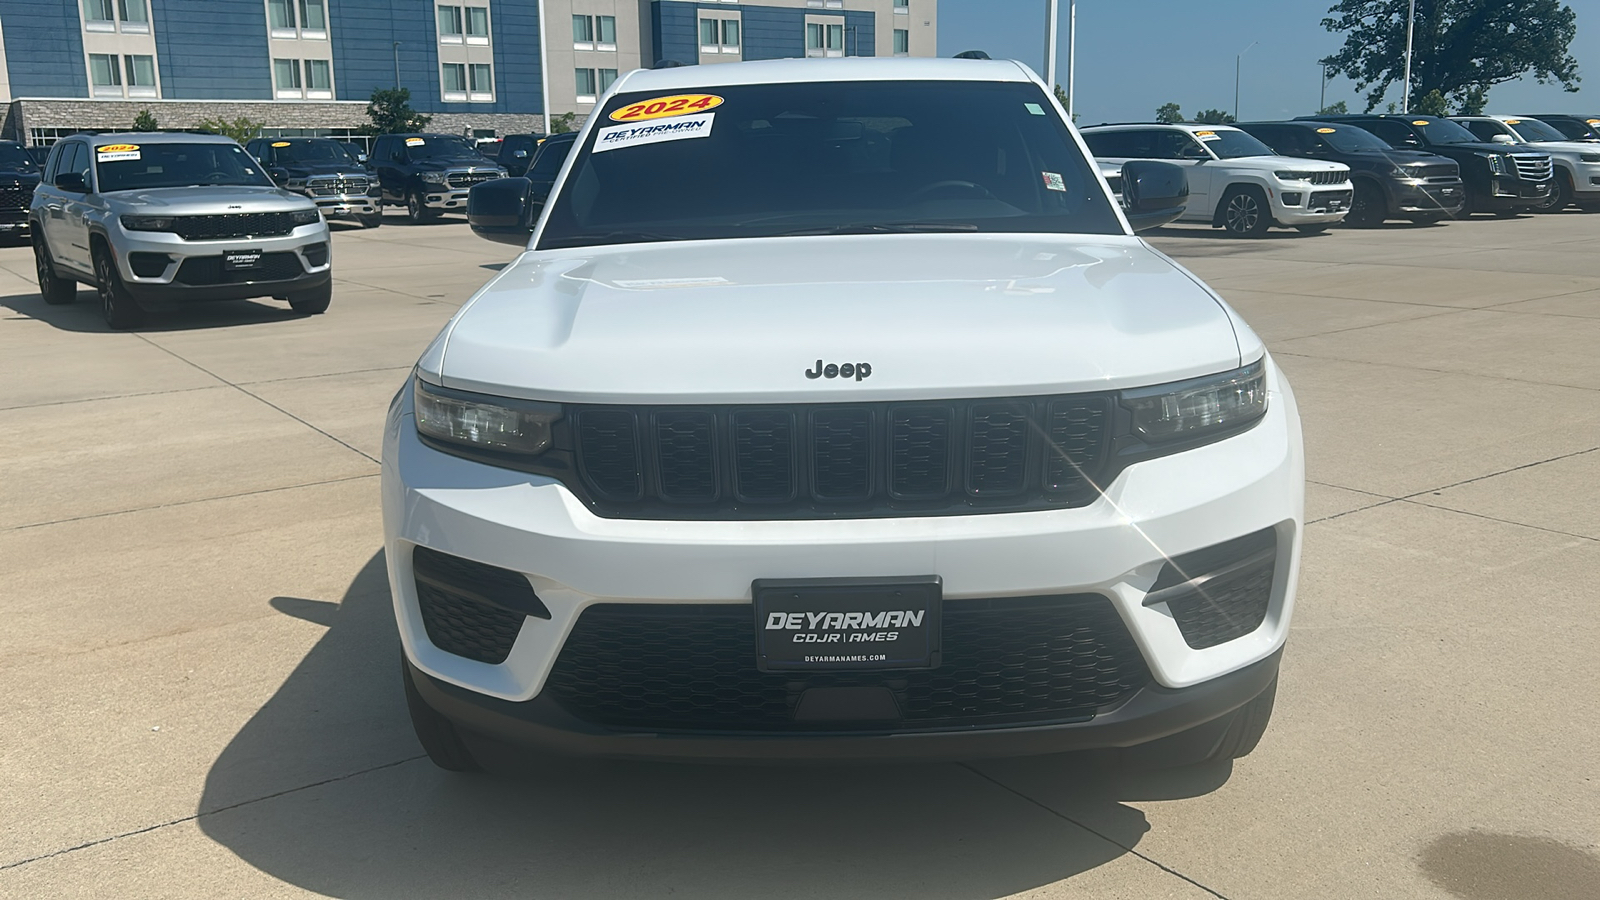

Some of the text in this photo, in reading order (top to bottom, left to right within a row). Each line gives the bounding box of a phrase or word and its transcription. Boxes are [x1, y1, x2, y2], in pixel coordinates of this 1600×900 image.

[620, 96, 713, 120] 2024
[603, 120, 706, 141] DEYARMAN
[609, 127, 702, 143] CERTIFIED PRE-OWNED
[804, 359, 872, 382] Jeep
[764, 609, 926, 630] DEYARMAN
[792, 631, 899, 643] CDJR AMES
[804, 653, 886, 662] DEYARMANAMES.COM
